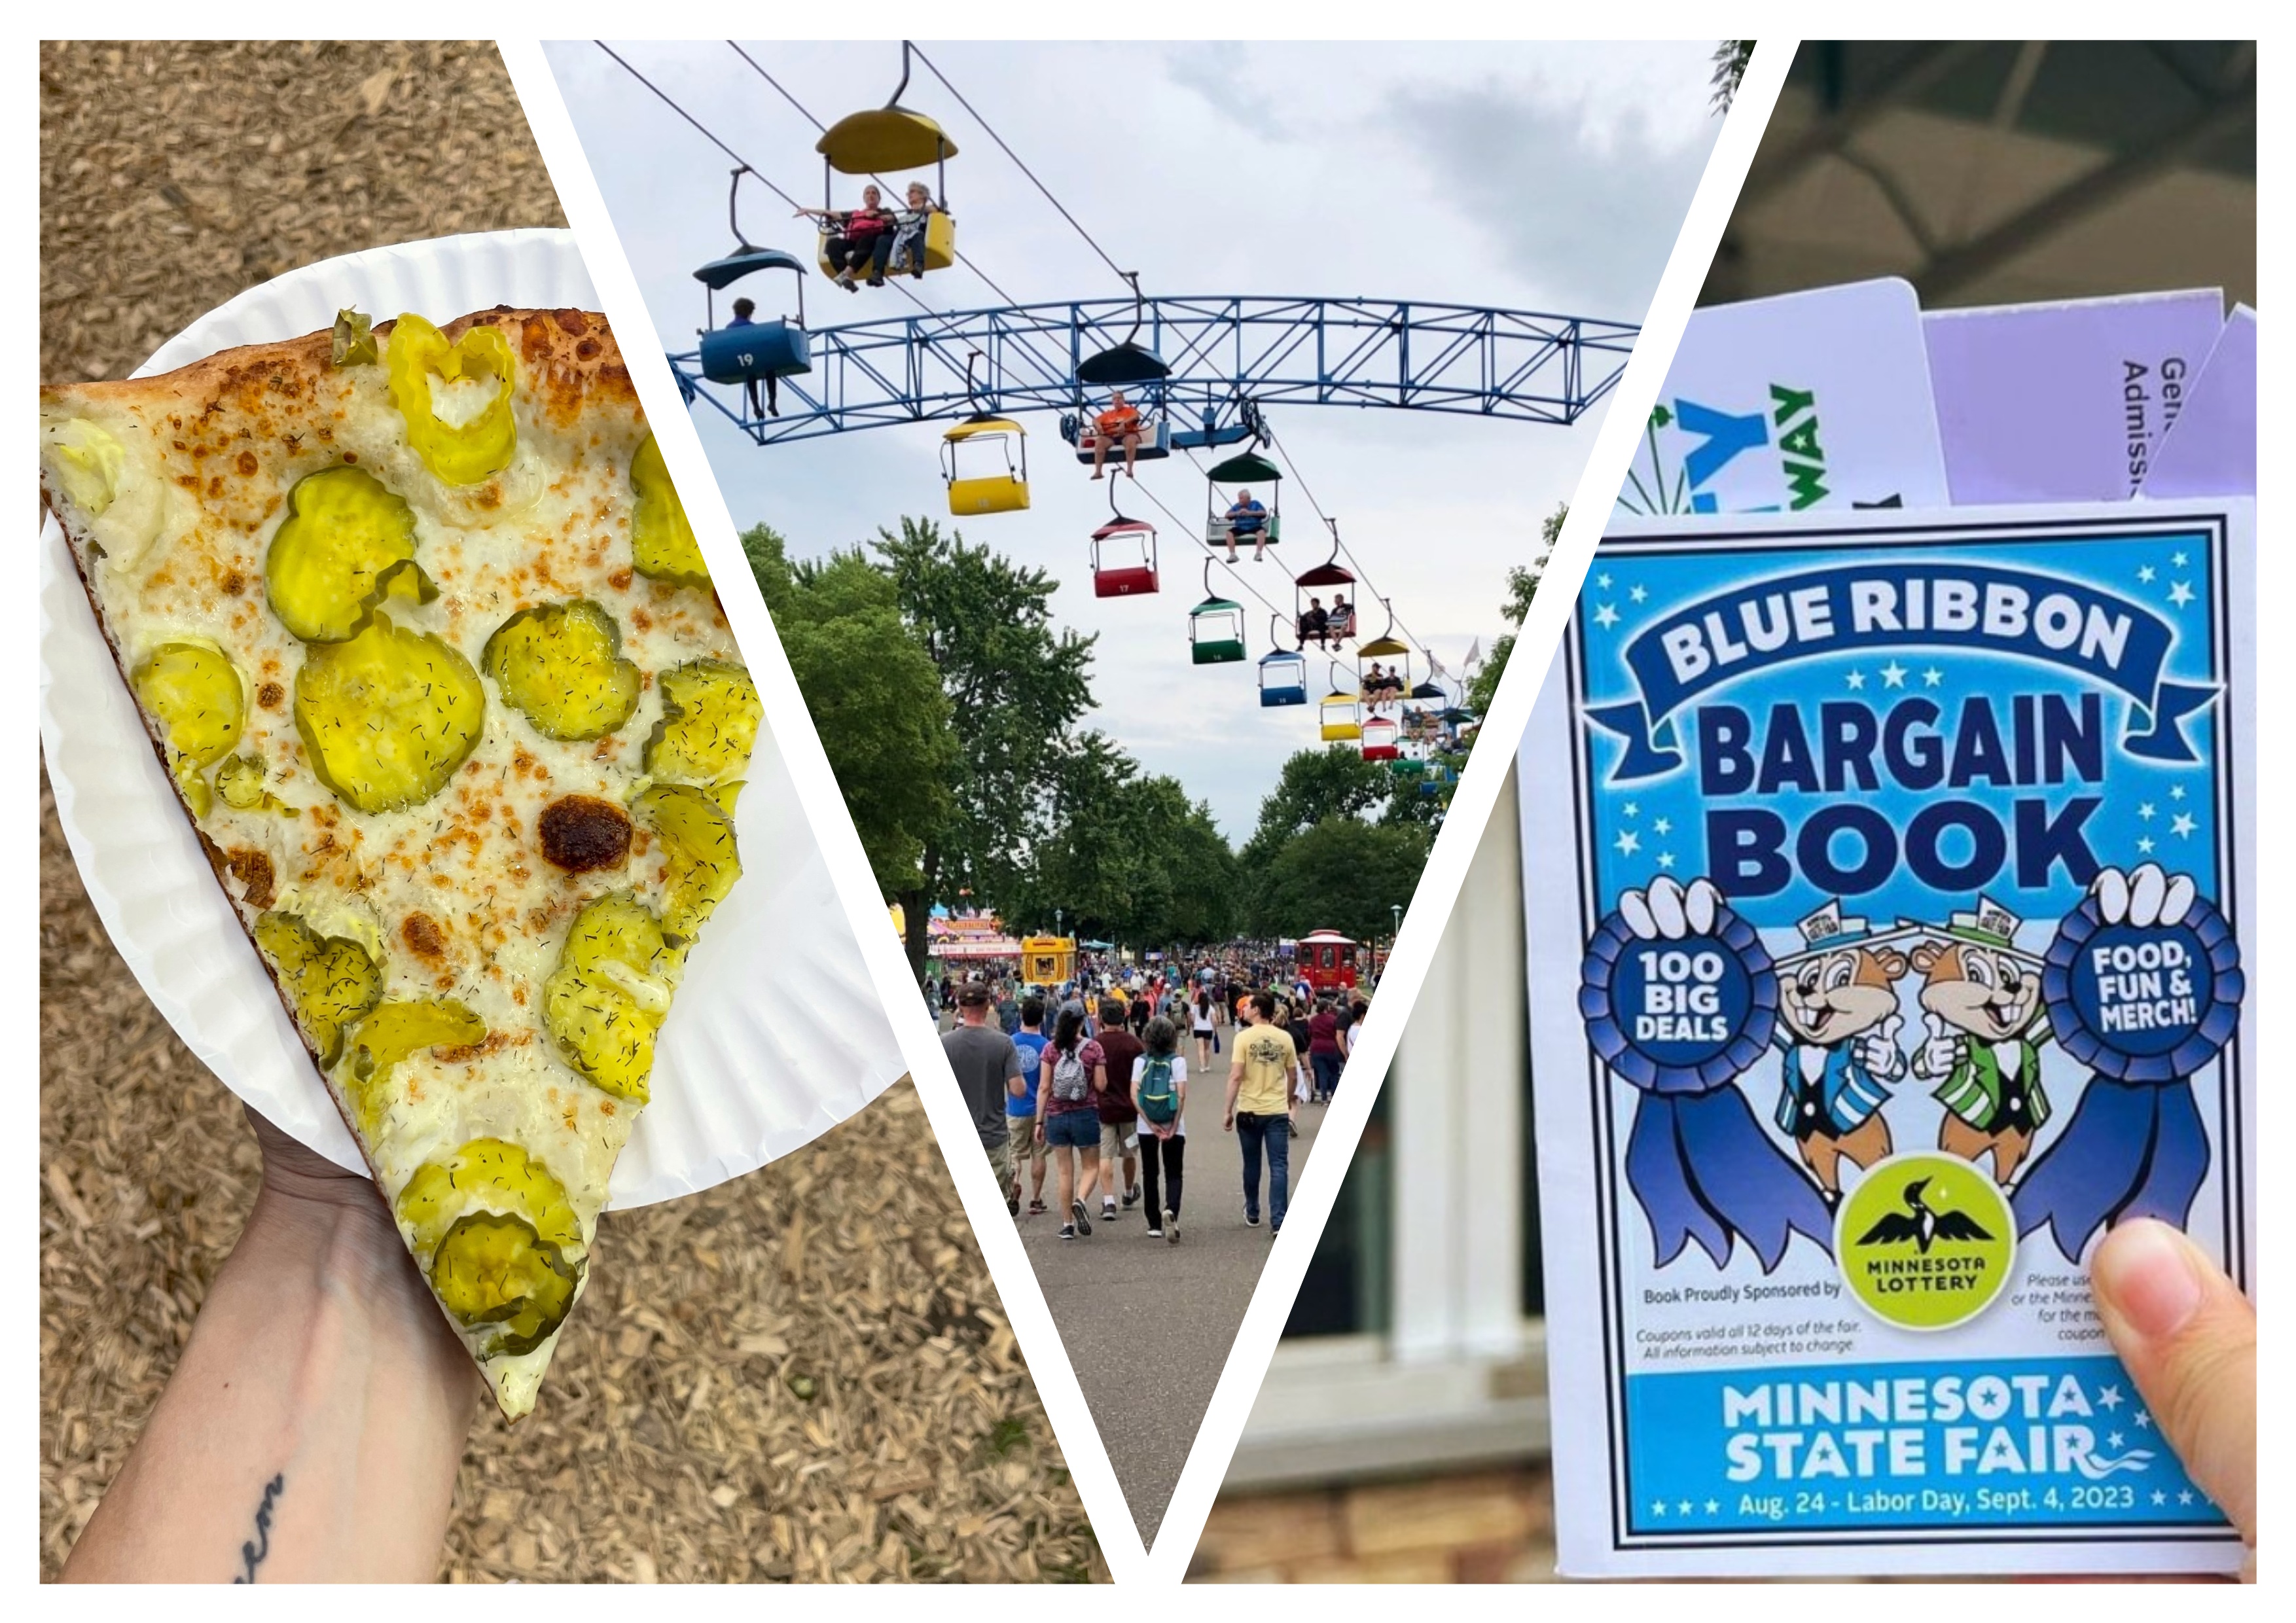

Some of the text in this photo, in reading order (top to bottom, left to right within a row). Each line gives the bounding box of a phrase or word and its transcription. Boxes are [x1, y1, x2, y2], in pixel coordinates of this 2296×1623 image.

[737, 353, 753, 366] 19
[1119, 584, 1130, 593] 17
[1661, 579, 2132, 684] BLUE RIBBON
[1698, 693, 2103, 796] BARGAIN
[1706, 797, 2103, 899] BOOK
[1638, 951, 1724, 982] 100
[2092, 940, 2192, 974] FOOD,
[1645, 984, 1719, 1014] BIG
[2098, 969, 2192, 1003] FUN &
[1637, 1016, 1728, 1041] DEALS
[2100, 997, 2197, 1033] MERCH!
[1867, 1257, 1986, 1275] MINNESOTA
[1644, 1280, 1841, 1304] Book Proudly Sponsored by
[1877, 1275, 1977, 1293] LOTTERY
[2028, 1274, 2069, 1287] Please
[2011, 1291, 2096, 1306] or the Minne
[2037, 1310, 2056, 1322] for
[2060, 1309, 2081, 1322] the
[1636, 1319, 1862, 1346] Coupons valid all 12 days of the fair.
[1644, 1346, 1660, 1359] All
[1663, 1342, 1738, 1358] information
[1742, 1340, 1787, 1357] subject
[1789, 1338, 1803, 1353] to
[1723, 1374, 2092, 1427] MINNESOTA
[1725, 1425, 2102, 1482] STATE FAIR
[1739, 1493, 1789, 1519] Aug.
[1797, 1492, 1825, 1513] 24
[1848, 1490, 1915, 1512] Labor
[1922, 1488, 1971, 1515] Day,
[1977, 1487, 2037, 1515] Sept.
[2043, 1488, 2064, 1512] 4,
[2071, 1486, 2134, 1508] 2023
